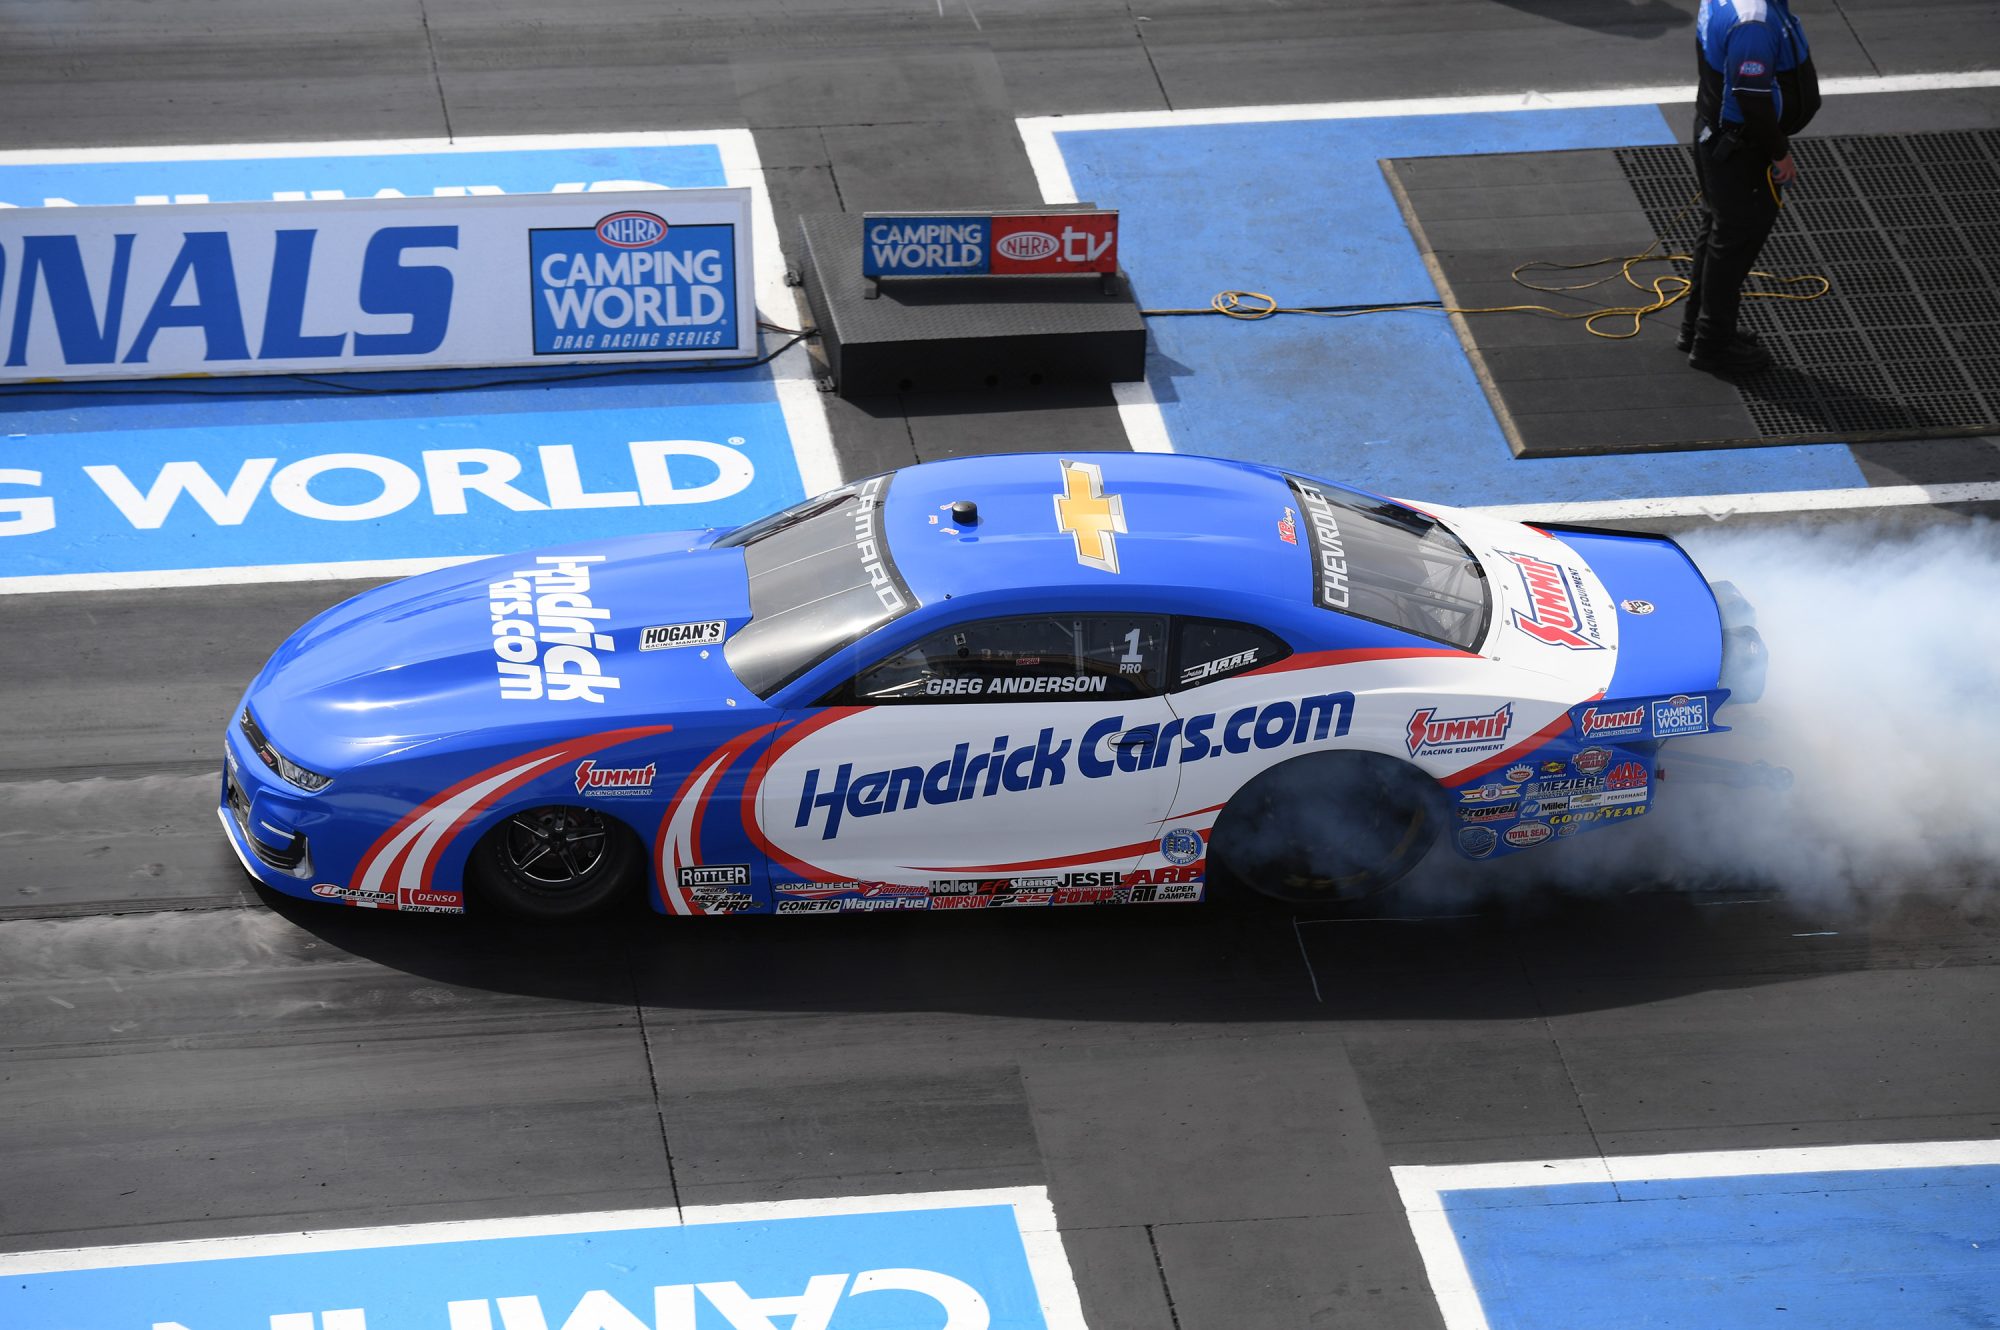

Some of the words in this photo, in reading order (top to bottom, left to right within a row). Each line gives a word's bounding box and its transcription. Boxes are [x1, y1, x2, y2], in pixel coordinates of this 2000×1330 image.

[607, 218, 657, 243] NHRA
[870, 224, 983, 245] CAMPING
[871, 244, 983, 268] WORLD
[541, 249, 723, 288] CAMPING
[0, 225, 459, 367] NALS
[543, 285, 727, 330] WORLD
[553, 334, 594, 350] DRAG
[601, 332, 660, 348] RACING
[666, 331, 722, 346] SERIES
[83, 439, 755, 530] WORLD
[855, 477, 906, 612] CAMARO
[1296, 481, 1350, 609] CHEVROLET
[1567, 566, 1591, 608] EQUIPMENT
[1583, 608, 1601, 640] RACING
[645, 622, 721, 644] HOGAN'S
[646, 641, 673, 649] RACING
[676, 637, 718, 645] MANIFOLDS
[1121, 628, 1144, 663] 1
[1119, 663, 1142, 674] PRO
[926, 678, 983, 695] GREG
[987, 676, 1108, 694] ANDERSON
[1656, 704, 1702, 719] CAMPING
[1657, 715, 1703, 729] WORLD
[1420, 747, 1453, 756] RACING
[1455, 743, 1505, 754] EQUIPMENT
[1607, 761, 1648, 782] MAC
[1538, 776, 1605, 793] MEZIERE
[1607, 778, 1647, 790] TOOLS
[585, 789, 611, 797] RACING
[1607, 790, 1647, 801] PERFORMANCE
[1541, 801, 1568, 812] Miller
[1509, 829, 1529, 839] TOTAL
[1531, 827, 1548, 838] SEAL
[681, 867, 746, 886] ROTTLER
[1010, 877, 1058, 889] Strange
[1057, 871, 1126, 887] JESEL
[1133, 867, 1202, 885] ARP
[775, 881, 860, 891] COMPUTECH
[929, 880, 978, 895] Holley
[978, 879, 1010, 895] EFI
[1131, 886, 1158, 902] ATI
[1164, 885, 1194, 893] SUPER
[337, 889, 396, 900] MAXIMA
[417, 893, 457, 903] DENSO
[932, 895, 987, 909] SIMPSON
[1054, 890, 1114, 904] COMP
[1158, 892, 1197, 900] DAMPER
[401, 904, 431, 913] SPARK
[434, 906, 463, 914] PLUGS
[714, 901, 752, 912] PRO
[779, 900, 841, 911] COMETIC
[842, 896, 930, 912] MagnaFuel
